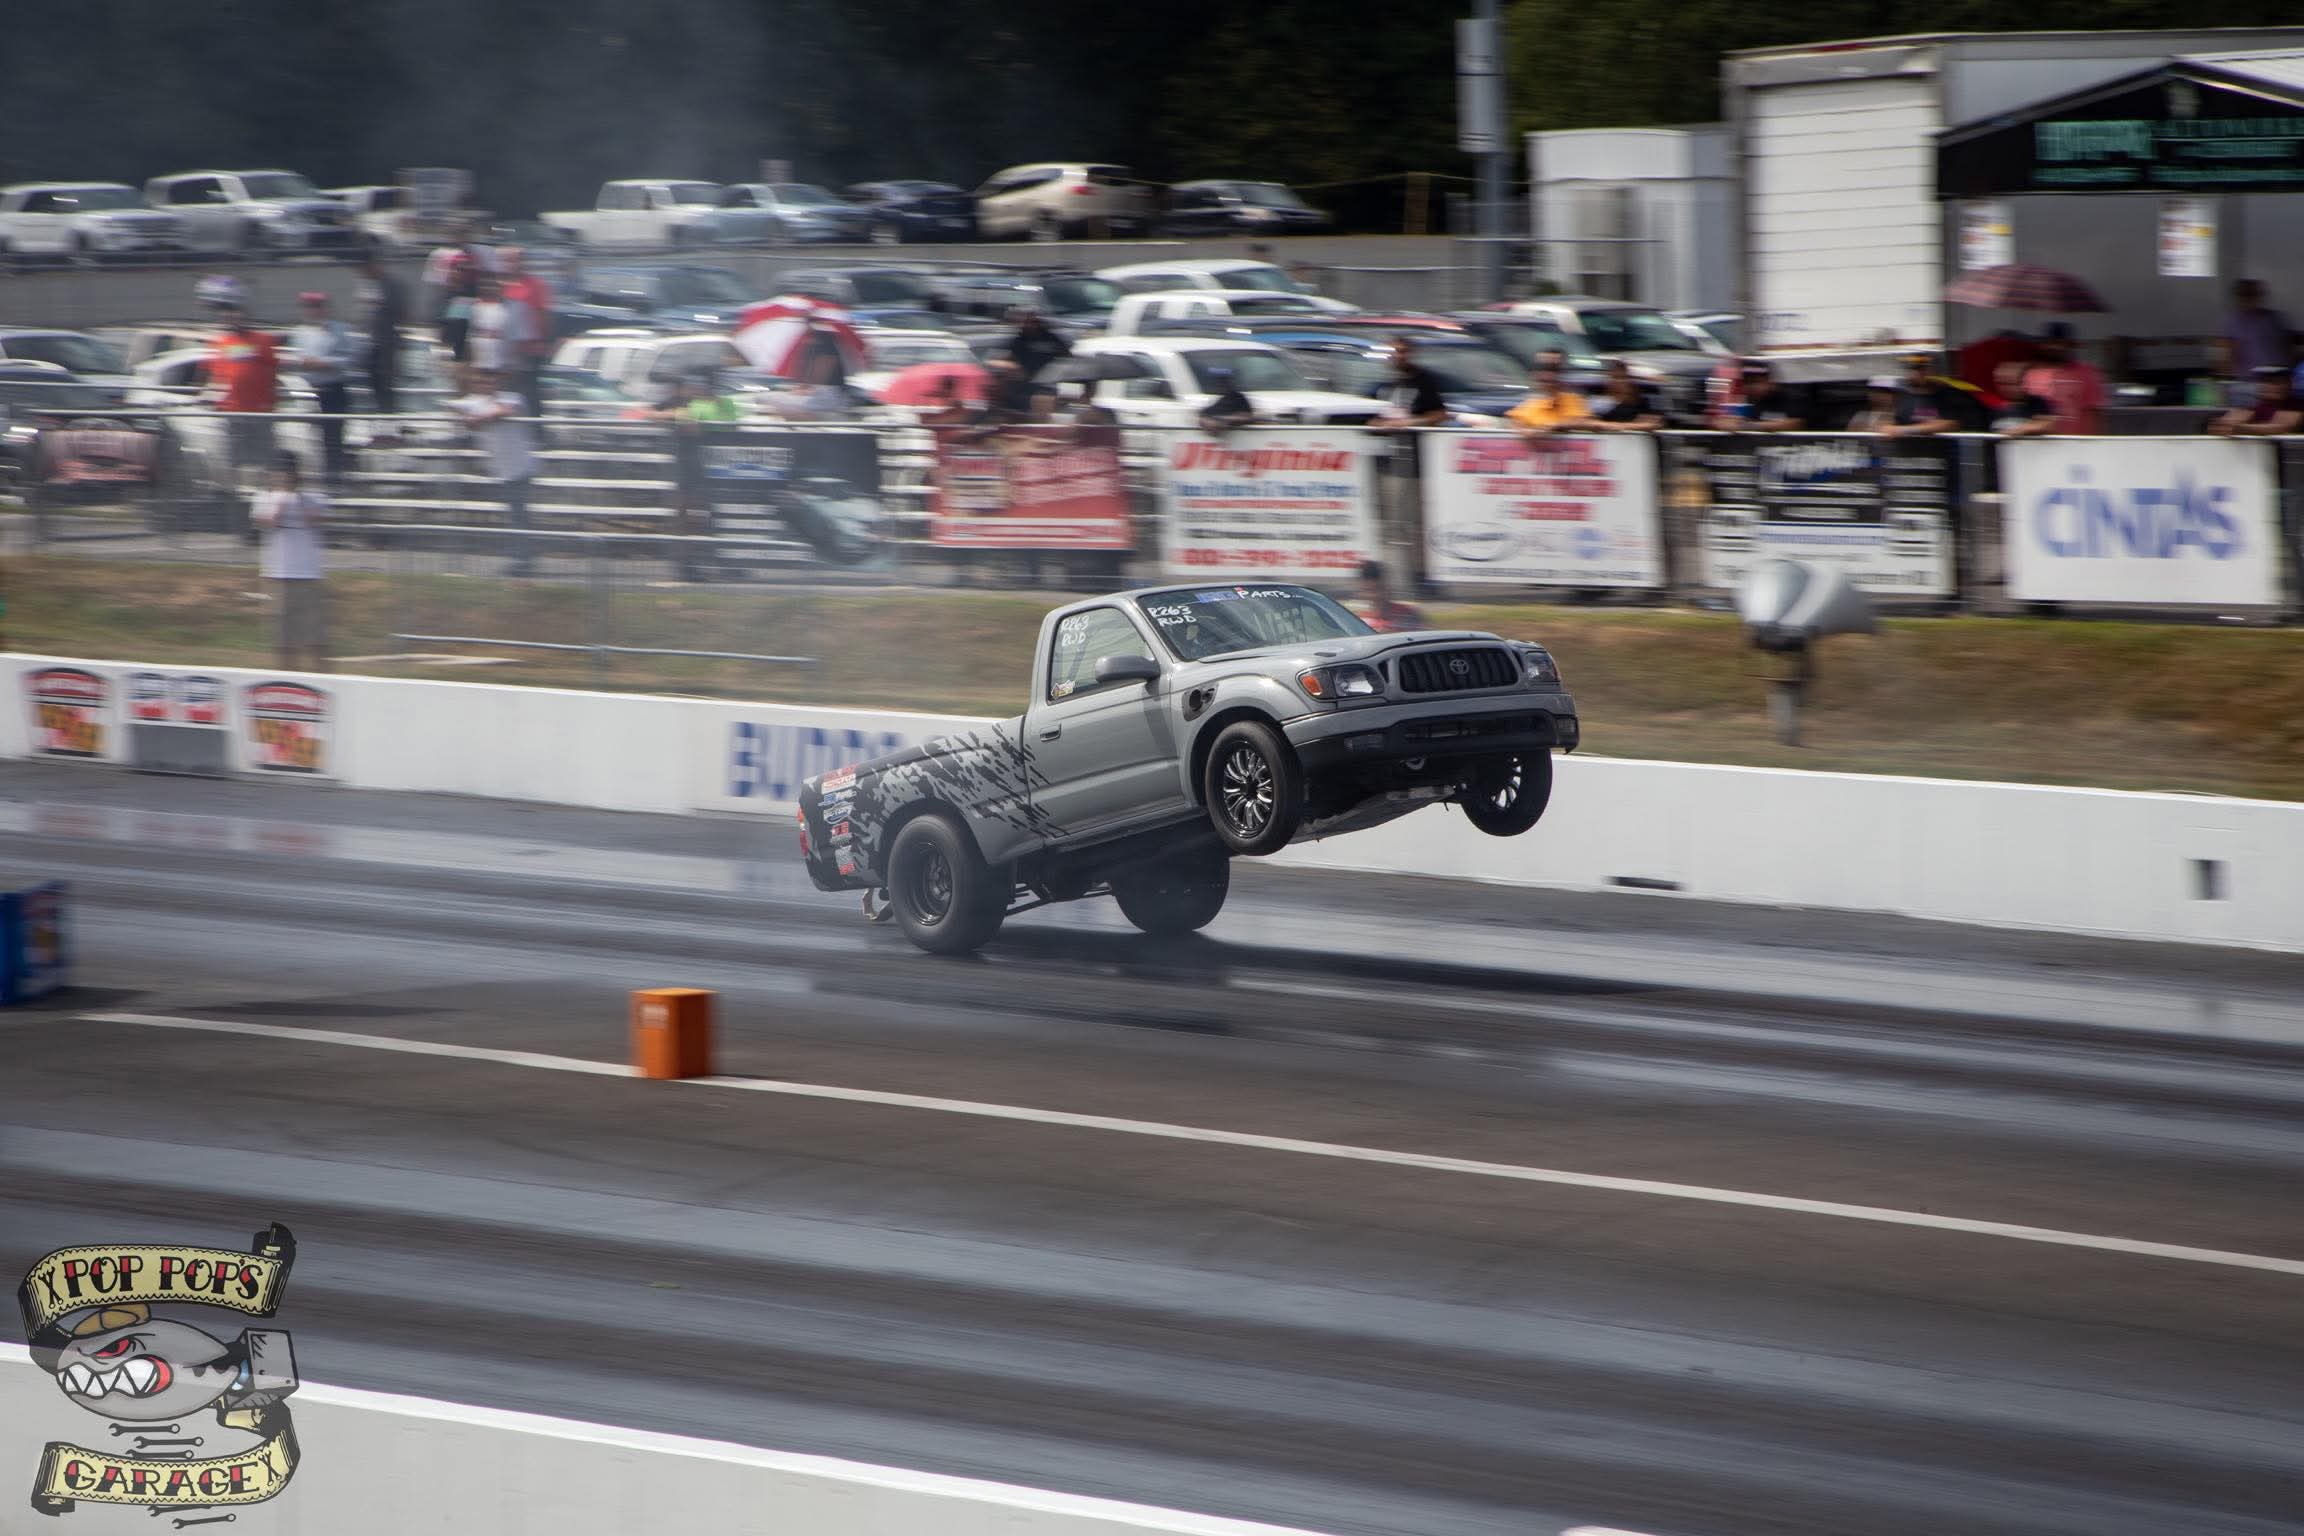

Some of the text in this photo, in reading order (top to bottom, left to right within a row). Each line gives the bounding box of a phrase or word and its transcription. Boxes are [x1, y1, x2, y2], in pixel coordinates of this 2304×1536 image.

[1171, 441, 1354, 478] Virginia
[1147, 606, 1192, 618] R263
[1157, 615, 1197, 627] RWD
[1062, 632, 1086, 647] RWD
[728, 722, 906, 801] BUD
